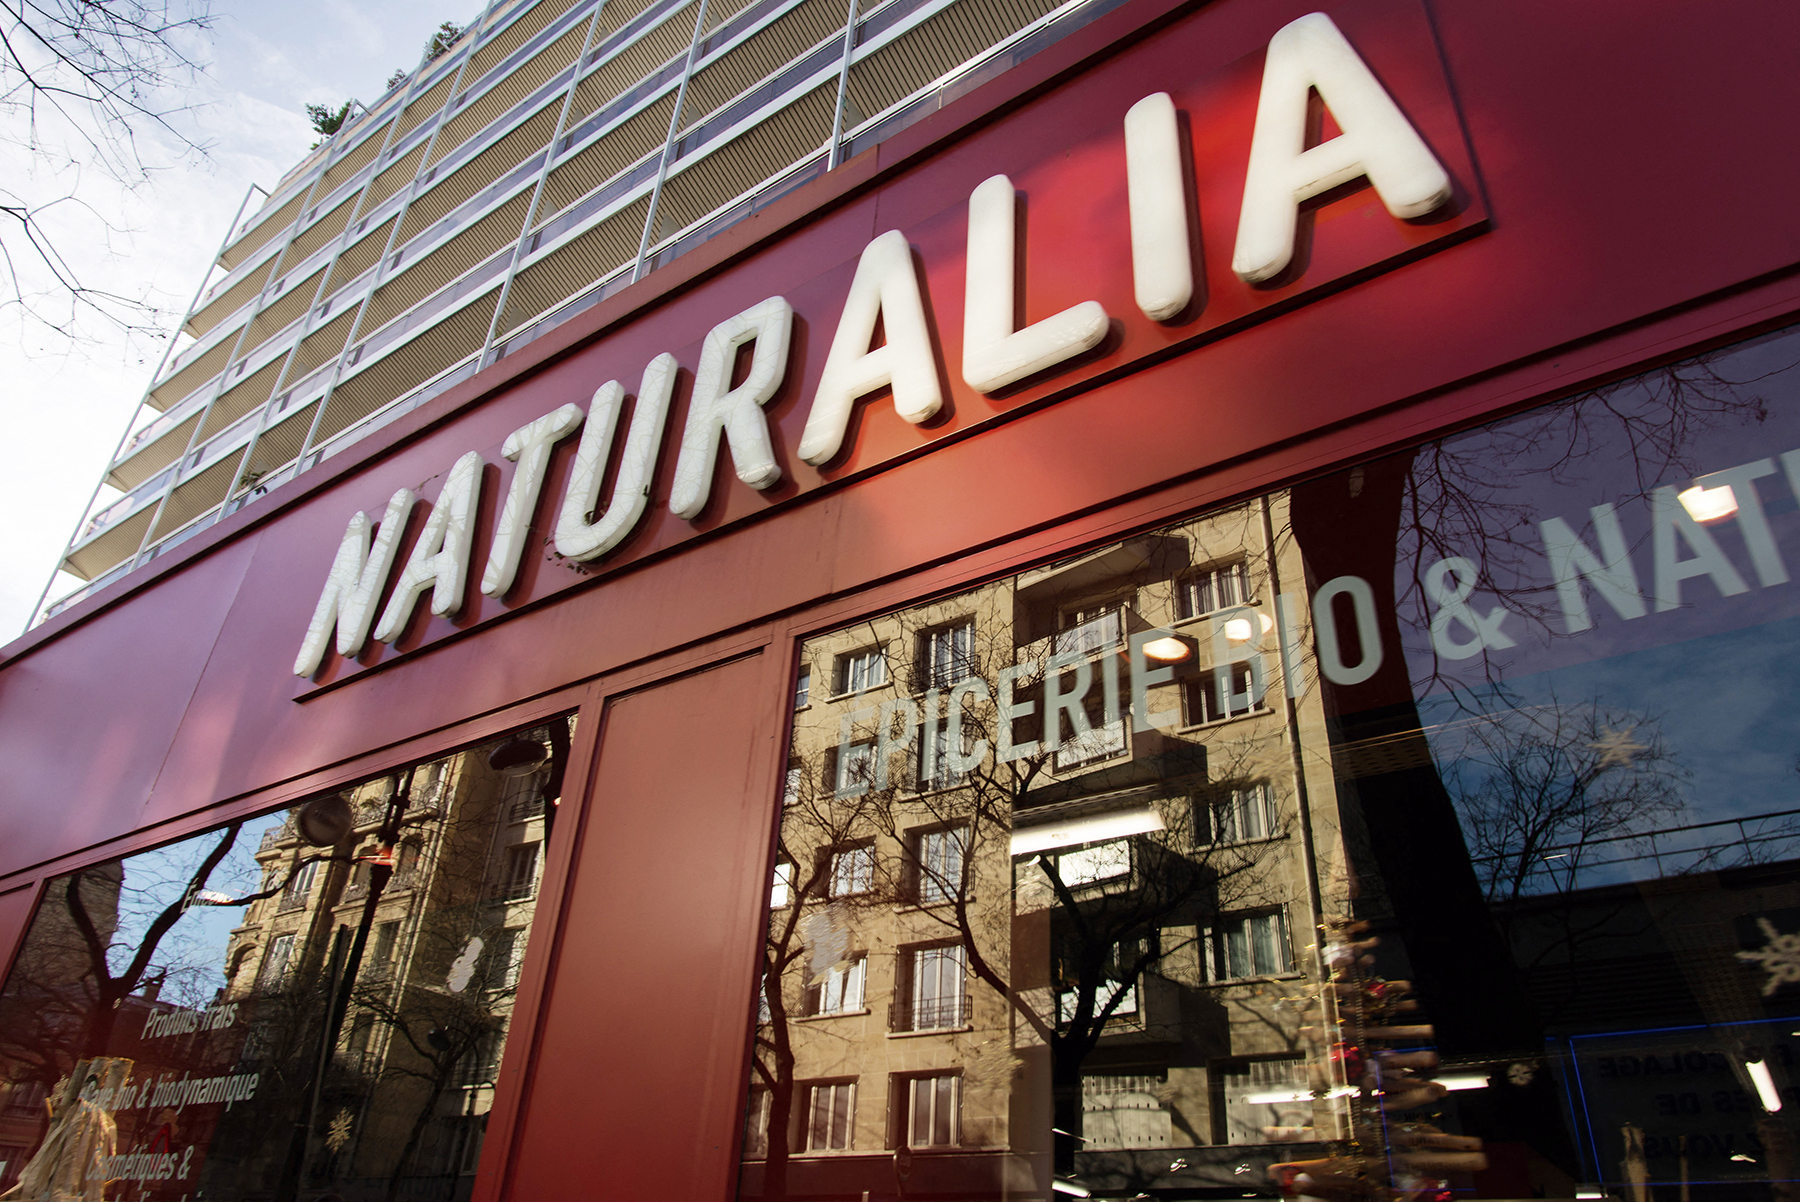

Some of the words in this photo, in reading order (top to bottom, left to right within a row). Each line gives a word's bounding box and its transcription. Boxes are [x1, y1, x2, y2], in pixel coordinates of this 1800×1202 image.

[294, 11, 1452, 678] NATURALIA
[1212, 574, 1385, 716] BIO
[1423, 556, 1518, 660] &
[140, 1006, 199, 1040] Produits
[200, 995, 239, 1032] frais
[111, 1076, 137, 1111] bio
[136, 1077, 153, 1109] &
[149, 1065, 260, 1116] biodynamique
[85, 1143, 179, 1191] Cosmétiques
[177, 1144, 195, 1180] &
